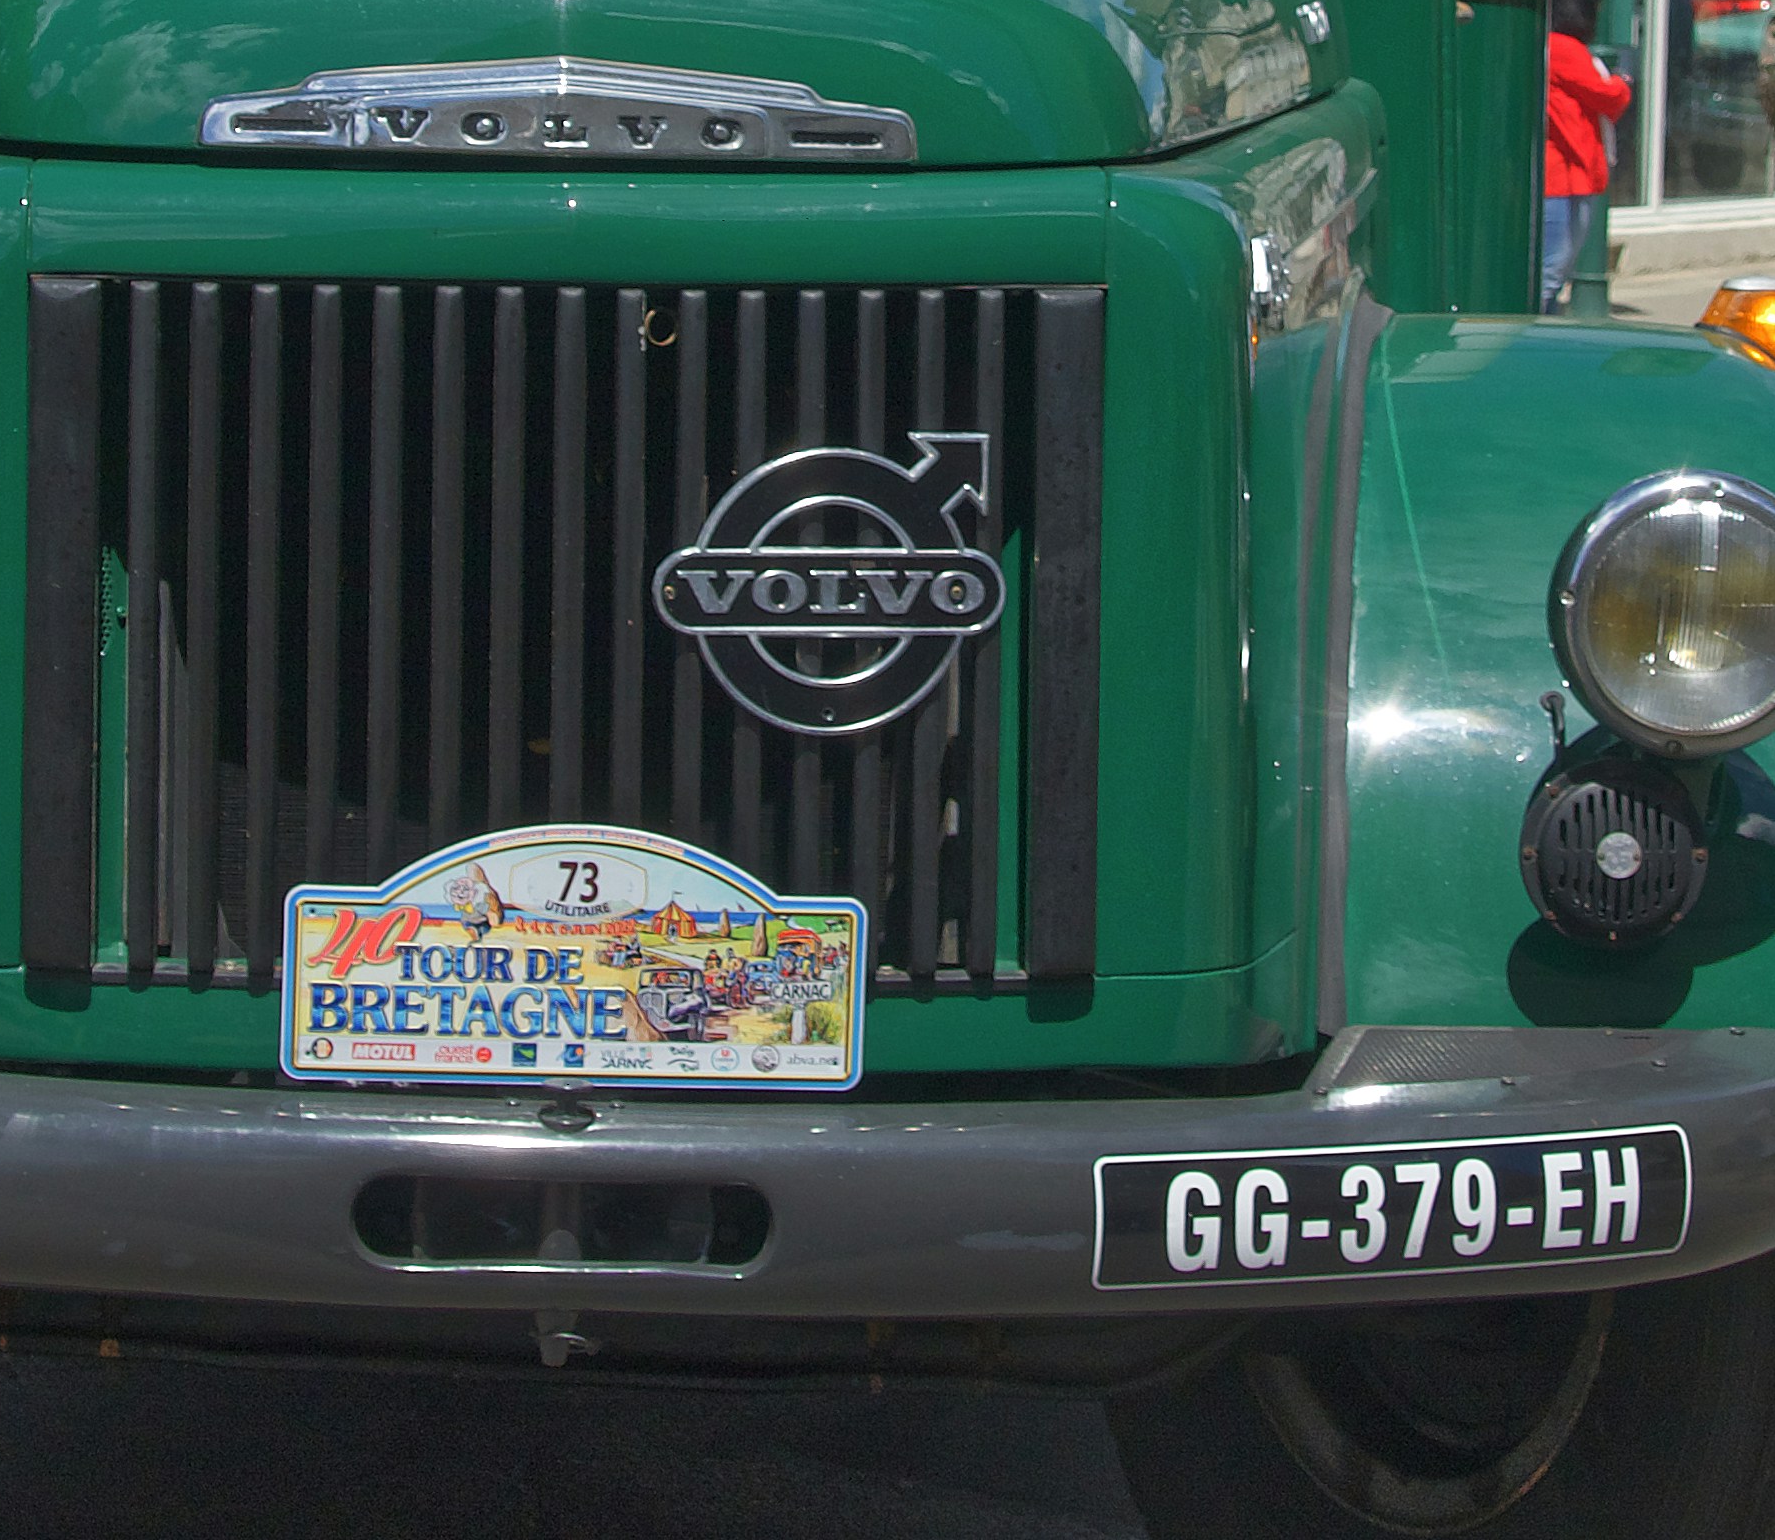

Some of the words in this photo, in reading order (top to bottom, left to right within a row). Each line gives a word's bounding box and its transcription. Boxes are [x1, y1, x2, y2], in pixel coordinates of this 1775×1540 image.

[372, 105, 746, 151] VOLVO
[677, 568, 985, 616] VOLVO
[558, 860, 599, 904] 73
[544, 899, 611, 917] UTILITAIRE
[308, 906, 422, 978] 40
[395, 943, 514, 983] TOUR
[523, 946, 584, 985] DE
[306, 981, 628, 1040] BRETAGNE
[772, 983, 829, 1000] CARNAC
[354, 1044, 414, 1060] MOTUL
[1165, 1146, 1642, 1273] GG-379-EH
